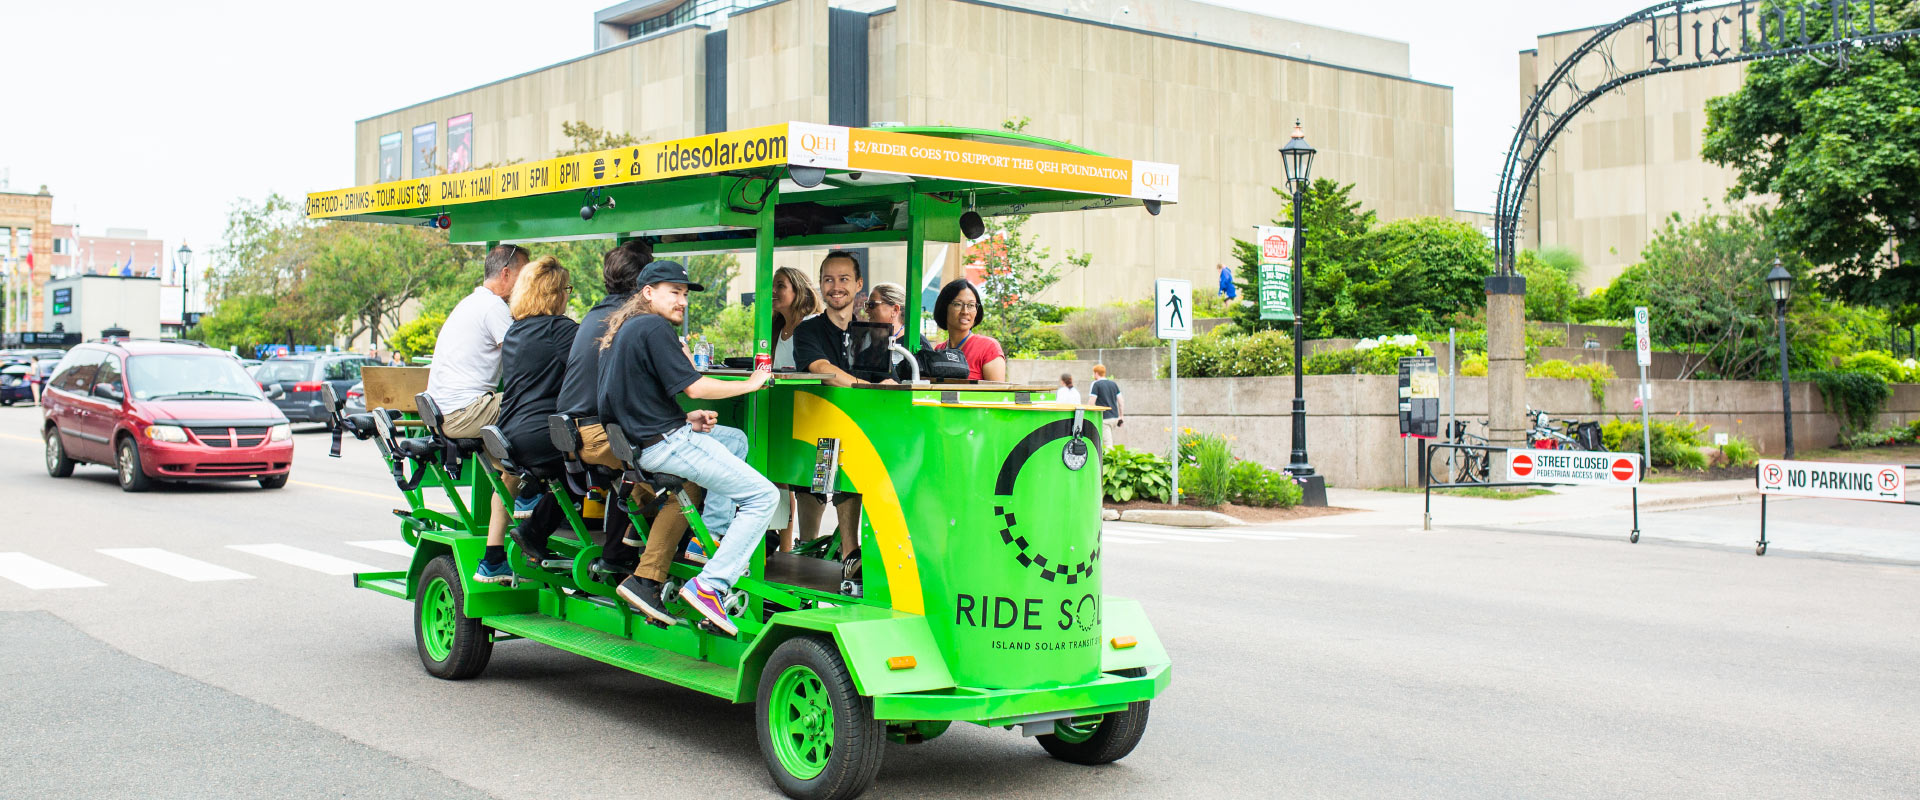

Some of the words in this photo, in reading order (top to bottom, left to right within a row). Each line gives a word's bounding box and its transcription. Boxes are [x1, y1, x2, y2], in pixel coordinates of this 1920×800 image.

[656, 135, 787, 174] ridesolar.com
[801, 133, 836, 156] QEH
[854, 140, 907, 157] $2/RIDER
[910, 146, 942, 161] GOES
[944, 150, 960, 163] TO
[962, 152, 1010, 168] SUPPORT
[1012, 157, 1034, 170] THE
[1036, 160, 1059, 174] QEH
[1061, 163, 1128, 181] FOUNDATION
[501, 171, 519, 193] 2PM
[530, 166, 549, 189] 5PM
[559, 161, 580, 184] 8PM
[1142, 171, 1170, 190] QEH
[441, 180, 467, 200] DAILY:
[471, 176, 491, 197] 11AM
[306, 196, 311, 216] 2
[312, 198, 320, 214] HR
[321, 196, 338, 213] FOOD
[345, 191, 370, 210] DRINKS
[376, 188, 396, 207] TOUR
[397, 186, 415, 206] JUST
[1537, 455, 1571, 468] STREET
[1573, 456, 1609, 470] CLOSED
[1536, 469, 1571, 478] PEDESTRIAN
[1571, 470, 1593, 479] ACCESS
[1594, 472, 1608, 480] ONLY
[1787, 469, 1807, 488] NO
[1811, 470, 1873, 491] PARKING
[955, 593, 1044, 631] RIDE
[992, 640, 1031, 650] ISLAND
[1035, 641, 1066, 651] SOLAR
[1069, 639, 1094, 650] TRANSIT
